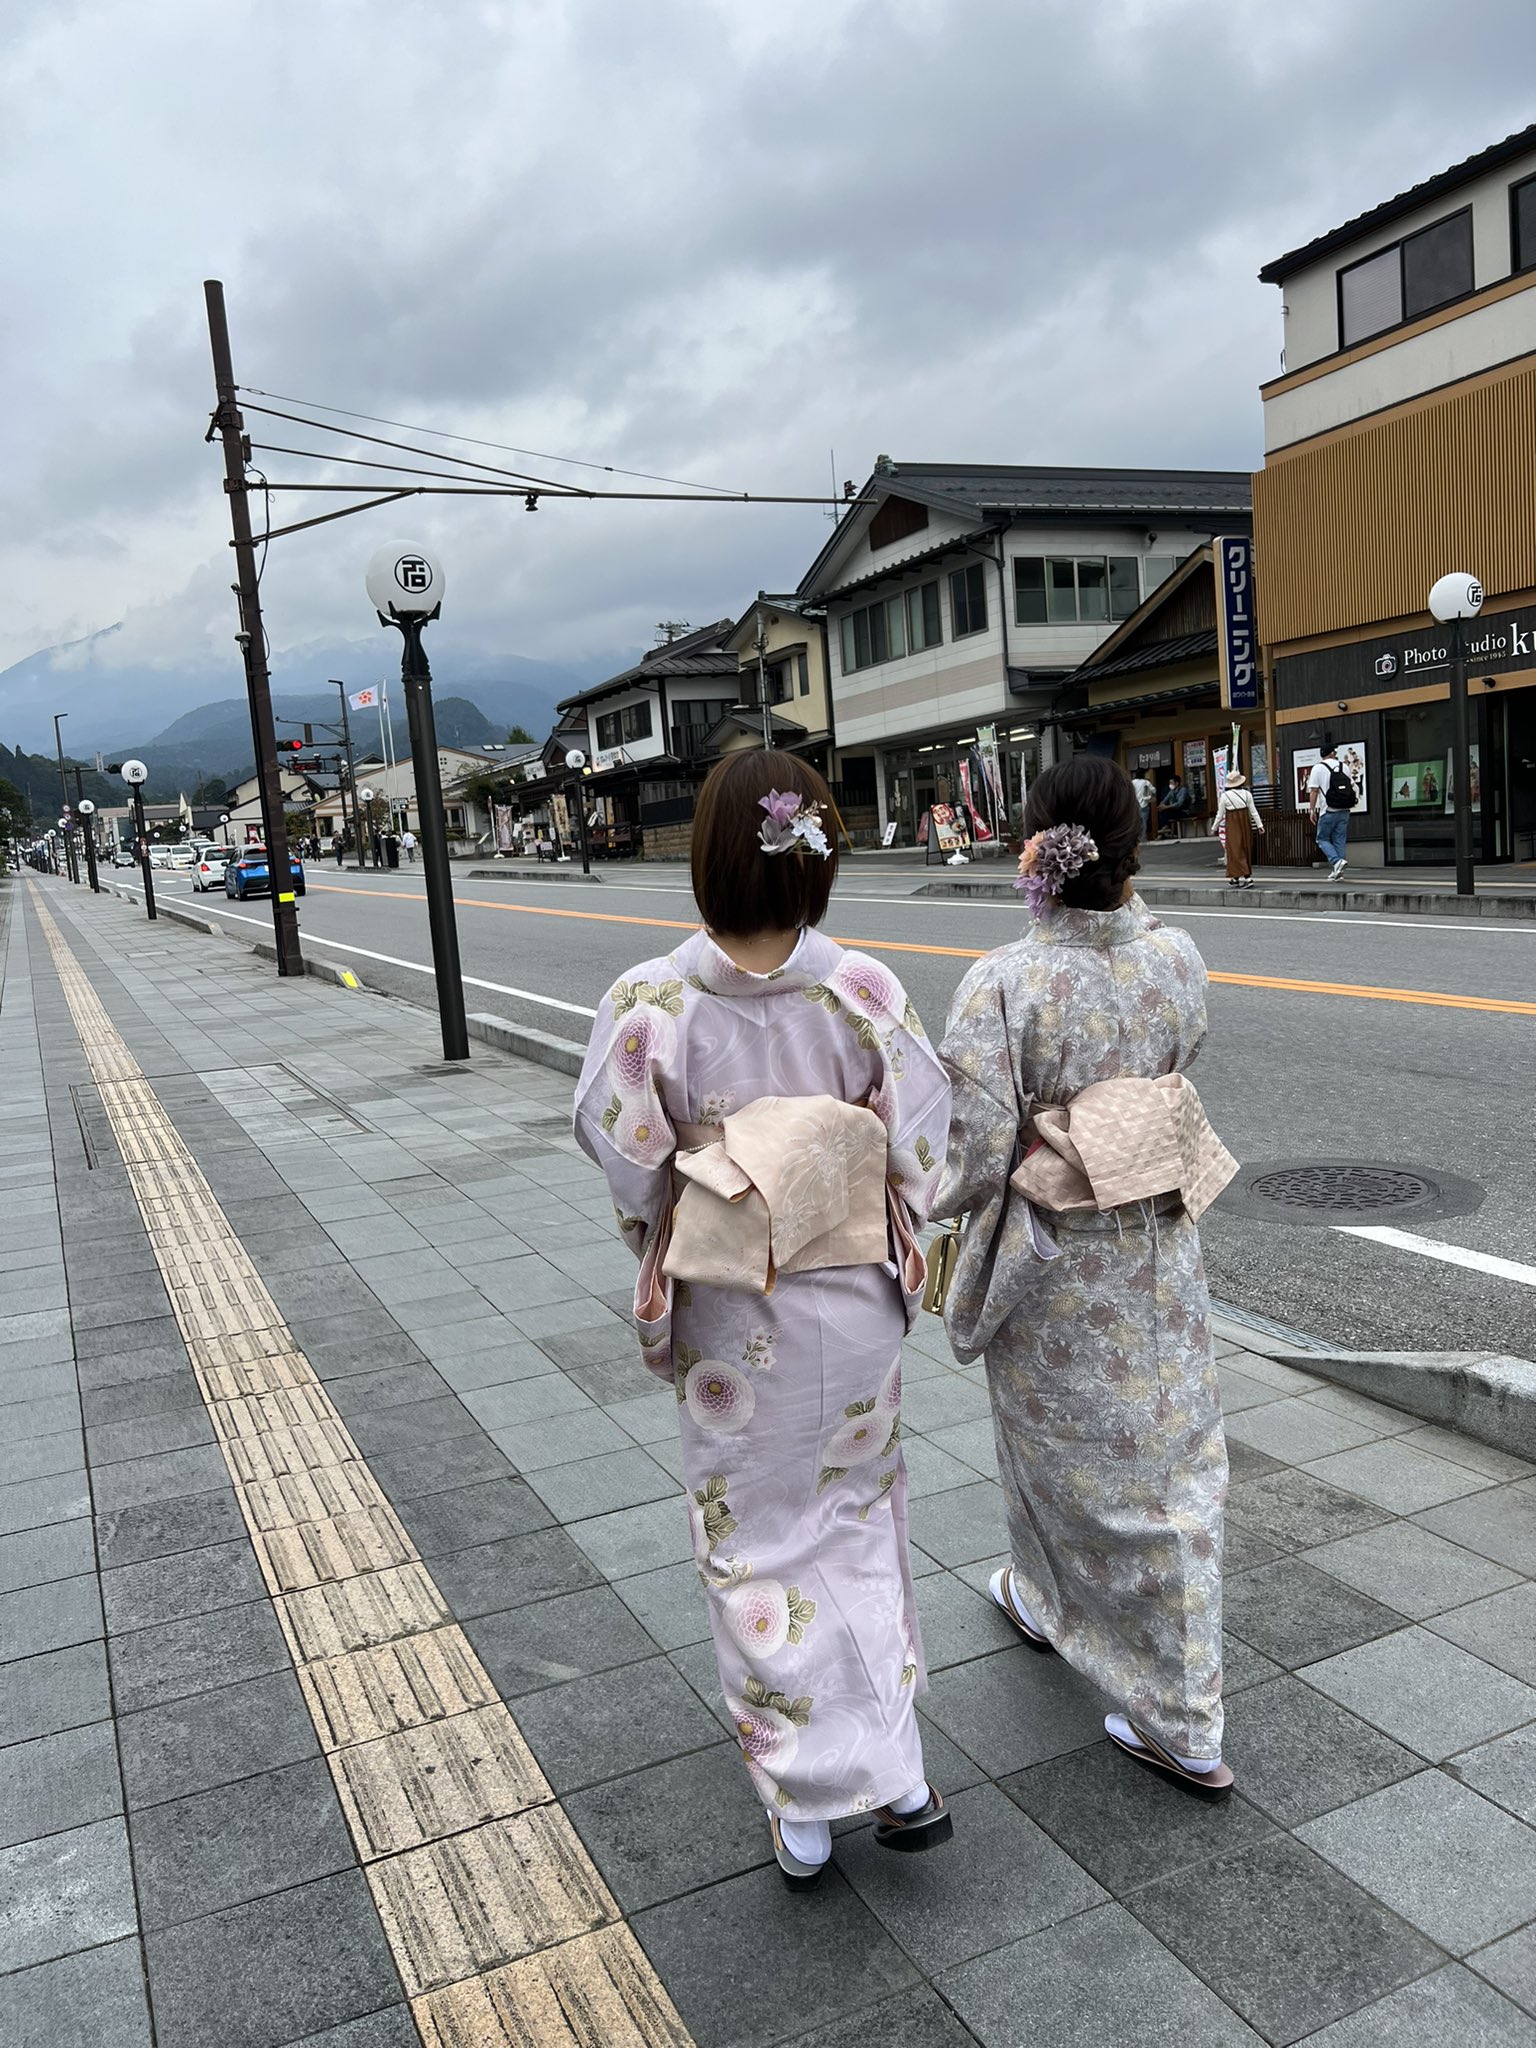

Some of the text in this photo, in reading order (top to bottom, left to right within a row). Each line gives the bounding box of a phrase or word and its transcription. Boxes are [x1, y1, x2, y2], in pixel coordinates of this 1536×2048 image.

[1228, 545, 1255, 687] クリーニング
[1404, 622, 1536, 666] Photo udio k
